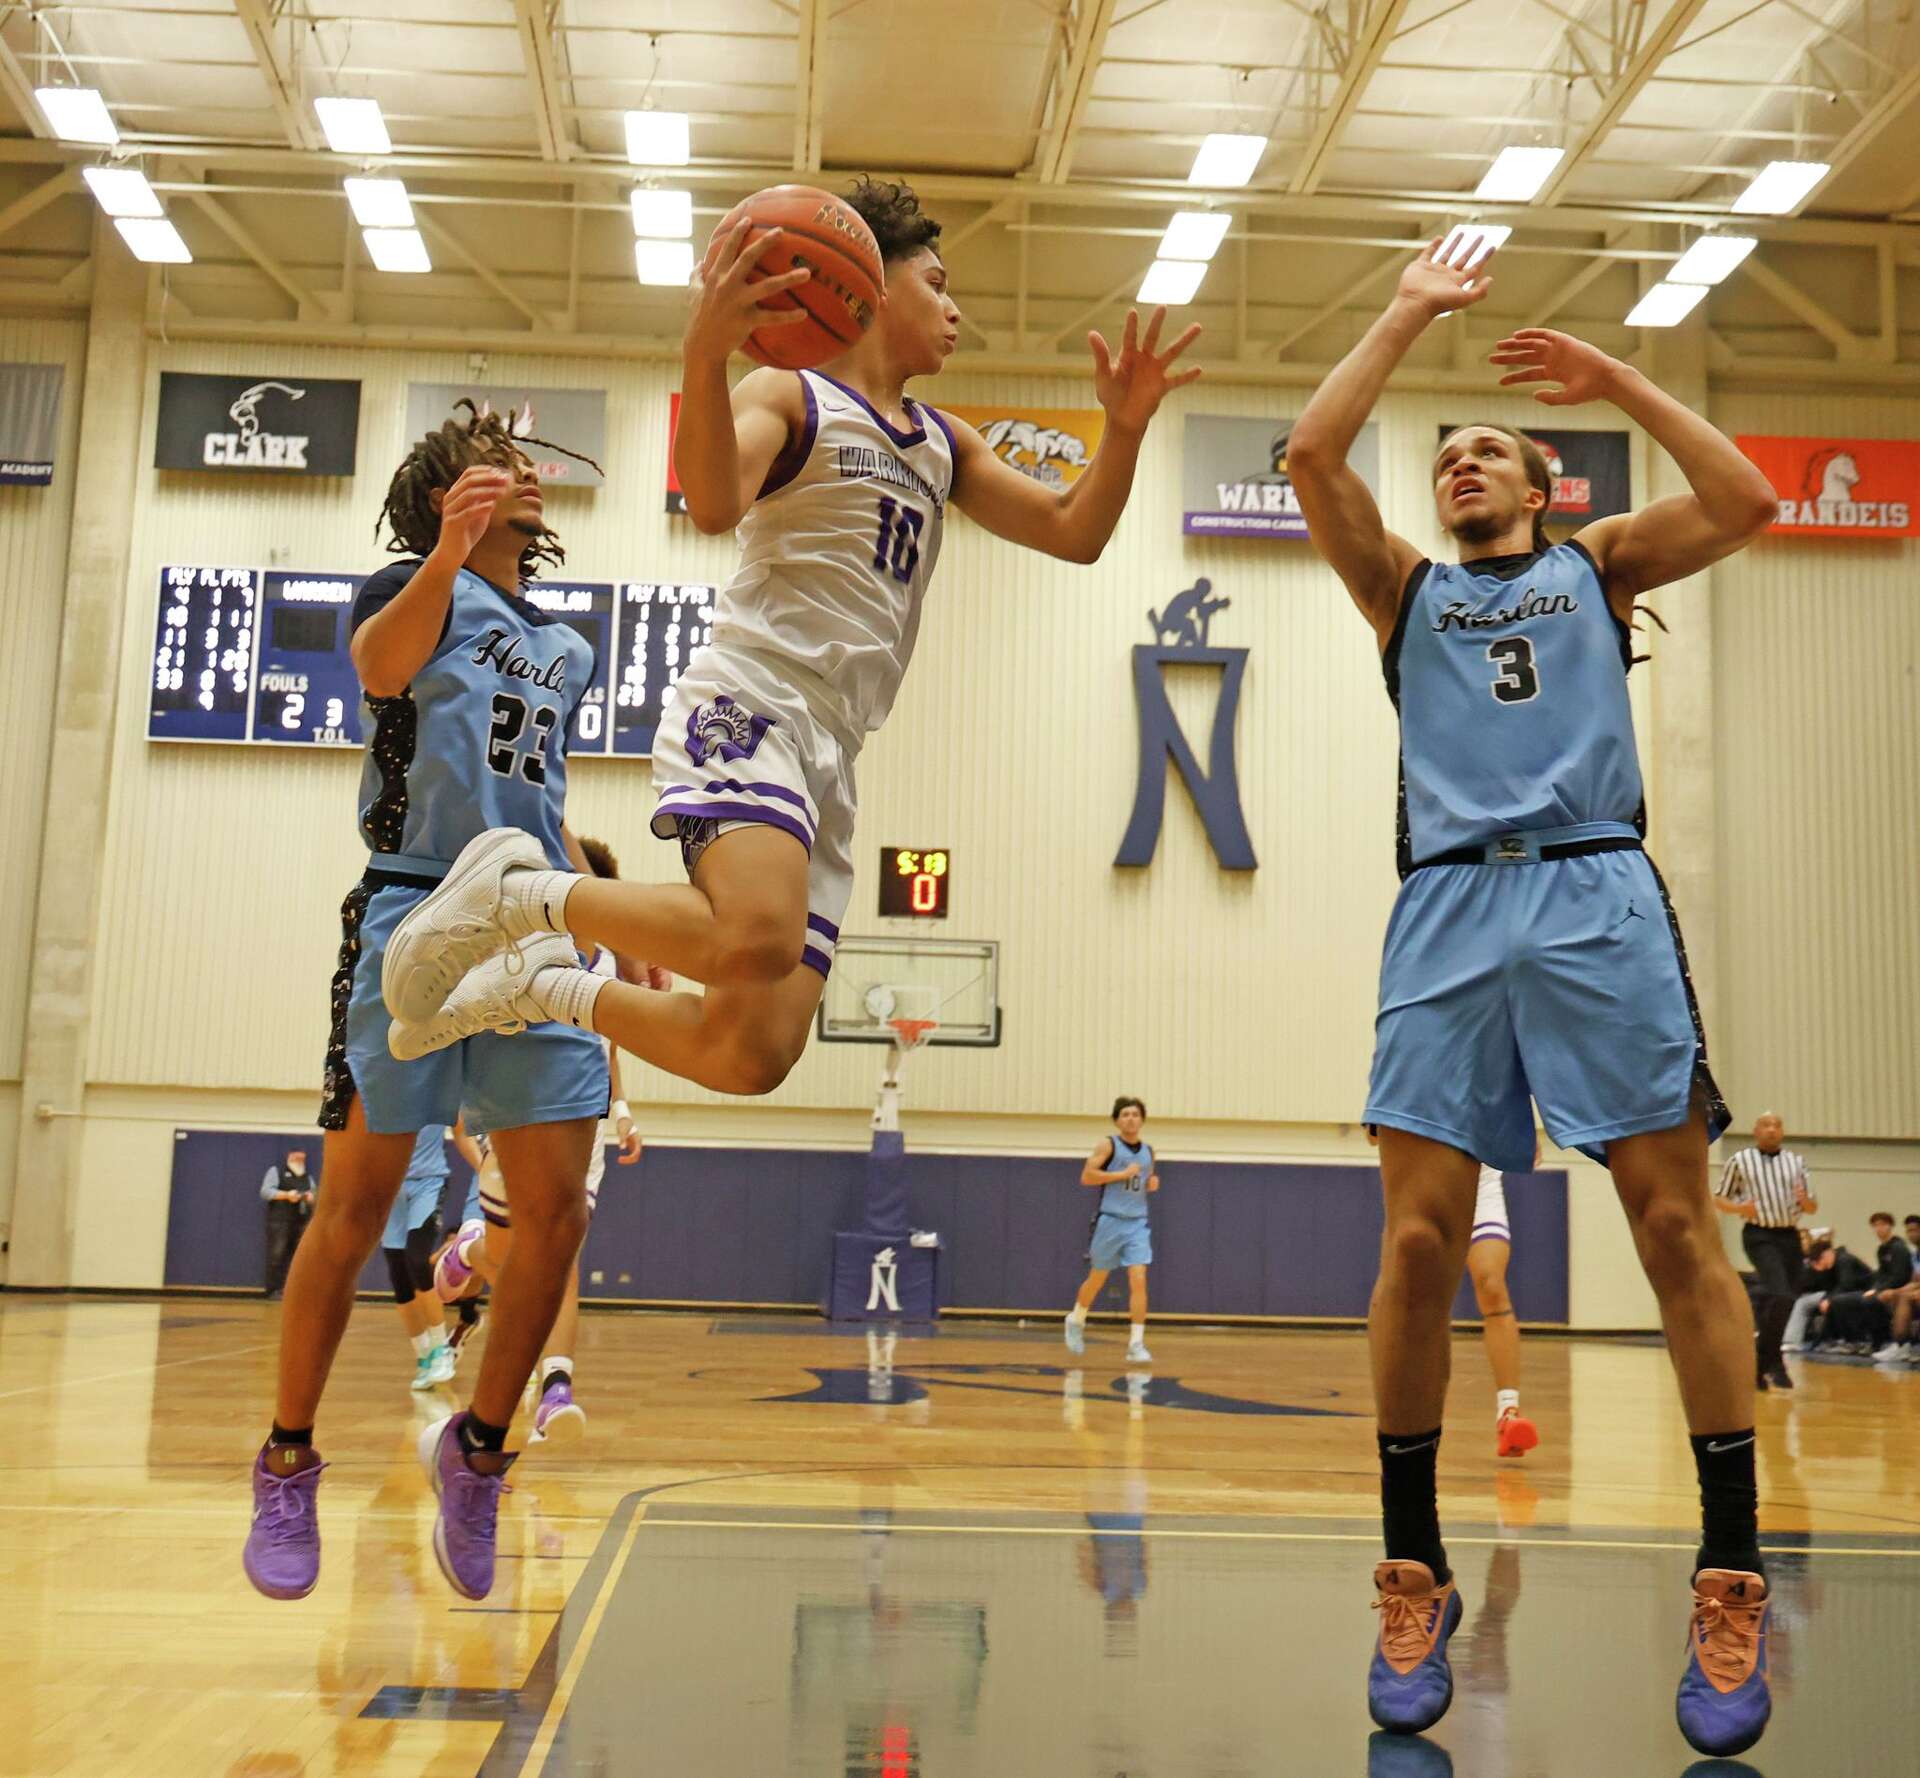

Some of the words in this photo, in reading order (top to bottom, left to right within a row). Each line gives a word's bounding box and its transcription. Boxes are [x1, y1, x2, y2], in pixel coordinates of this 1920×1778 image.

[1, 463, 53, 475] ACADEMY
[204, 432, 309, 468] CLARK
[873, 496, 924, 585] 10
[1432, 586, 1579, 634] Harlan
[260, 674, 309, 692] FOULS
[1486, 635, 1541, 705] 3
[282, 693, 305, 729] 2
[325, 698, 344, 727] 3
[484, 690, 560, 790] 23
[913, 873, 937, 912] 0
